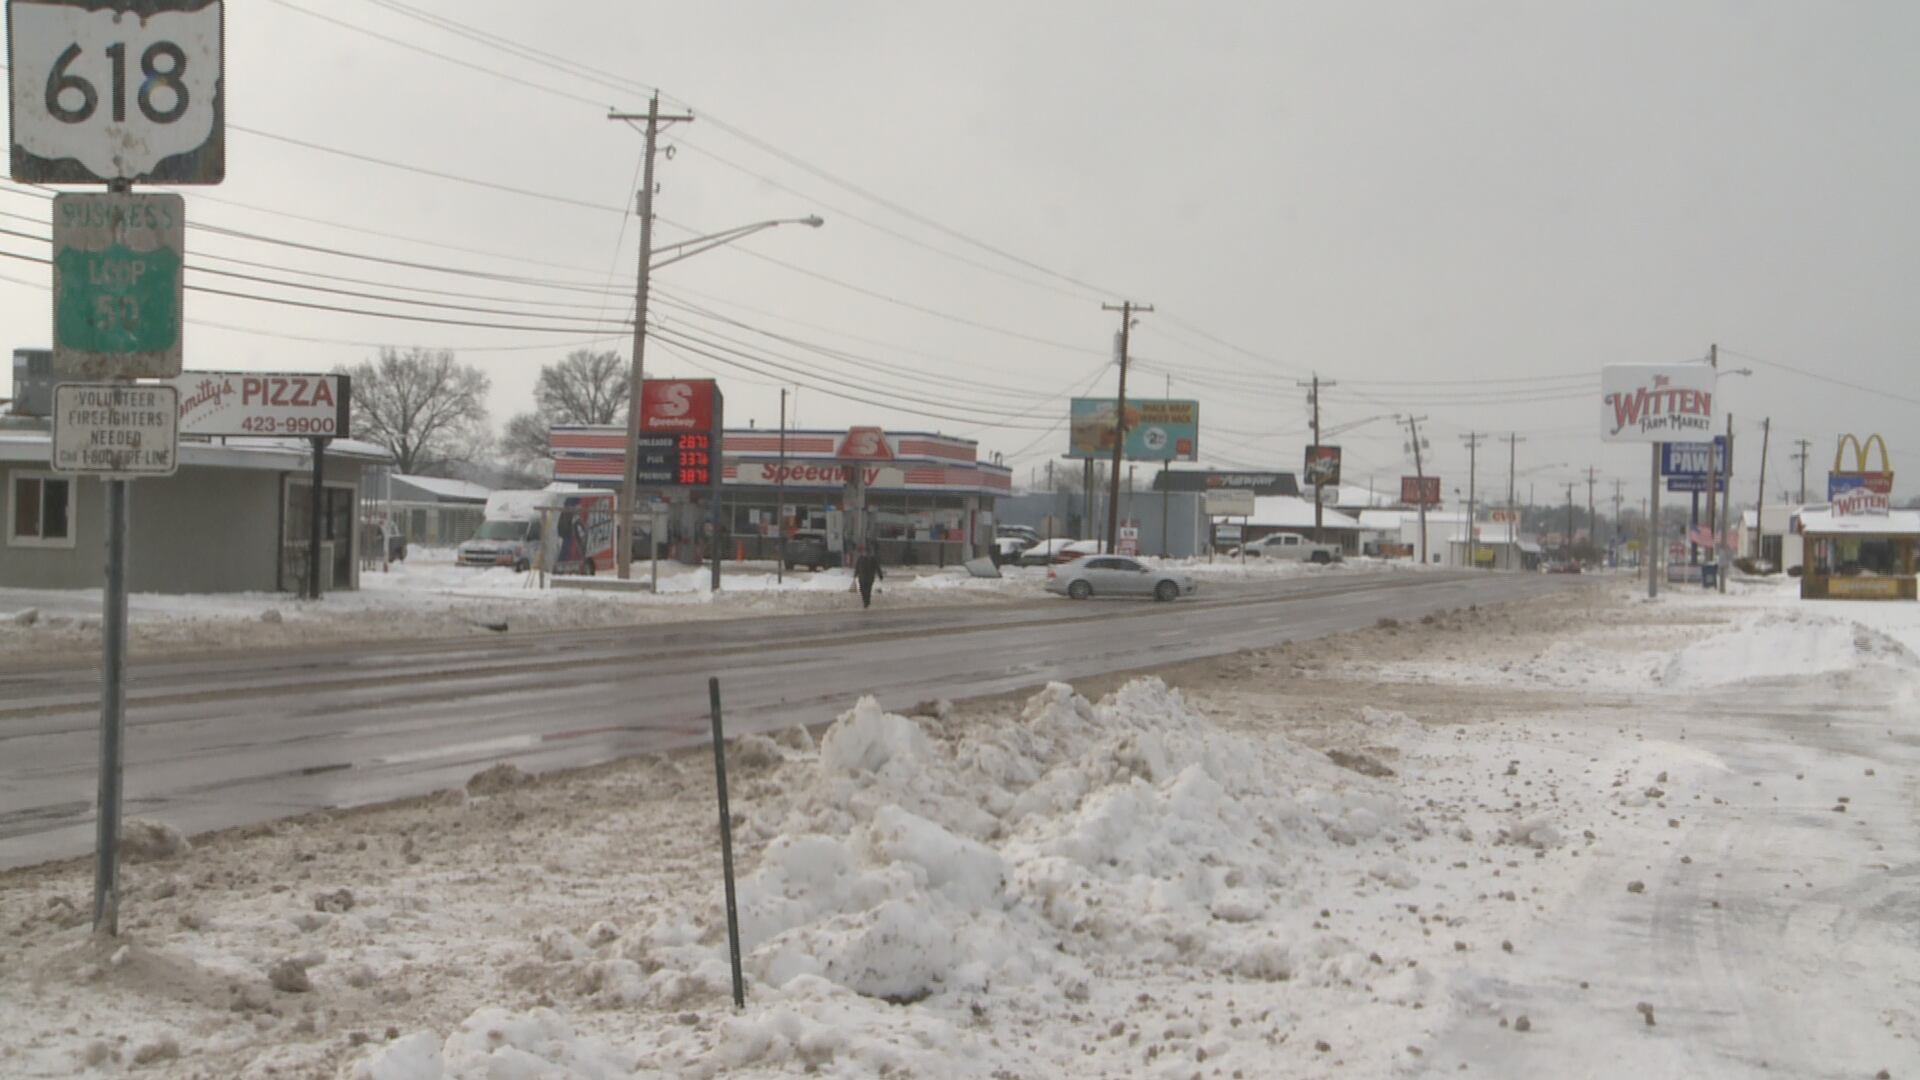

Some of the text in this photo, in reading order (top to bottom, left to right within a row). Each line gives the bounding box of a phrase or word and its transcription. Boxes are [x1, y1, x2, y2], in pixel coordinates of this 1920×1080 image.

[45, 41, 190, 124] 618
[88, 260, 146, 286] LOOP
[96, 294, 140, 331] 50
[79, 391, 156, 407] VOLUNTEER
[241, 377, 335, 407] PIZZA
[68, 409, 164, 427] FIREFIGHTERS
[1604, 386, 1712, 436] WITTEN
[241, 416, 335, 433] 423-9900
[1669, 414, 1711, 432] MARKET
[90, 430, 142, 447] NEEDED
[1669, 451, 1724, 473] PAWN
